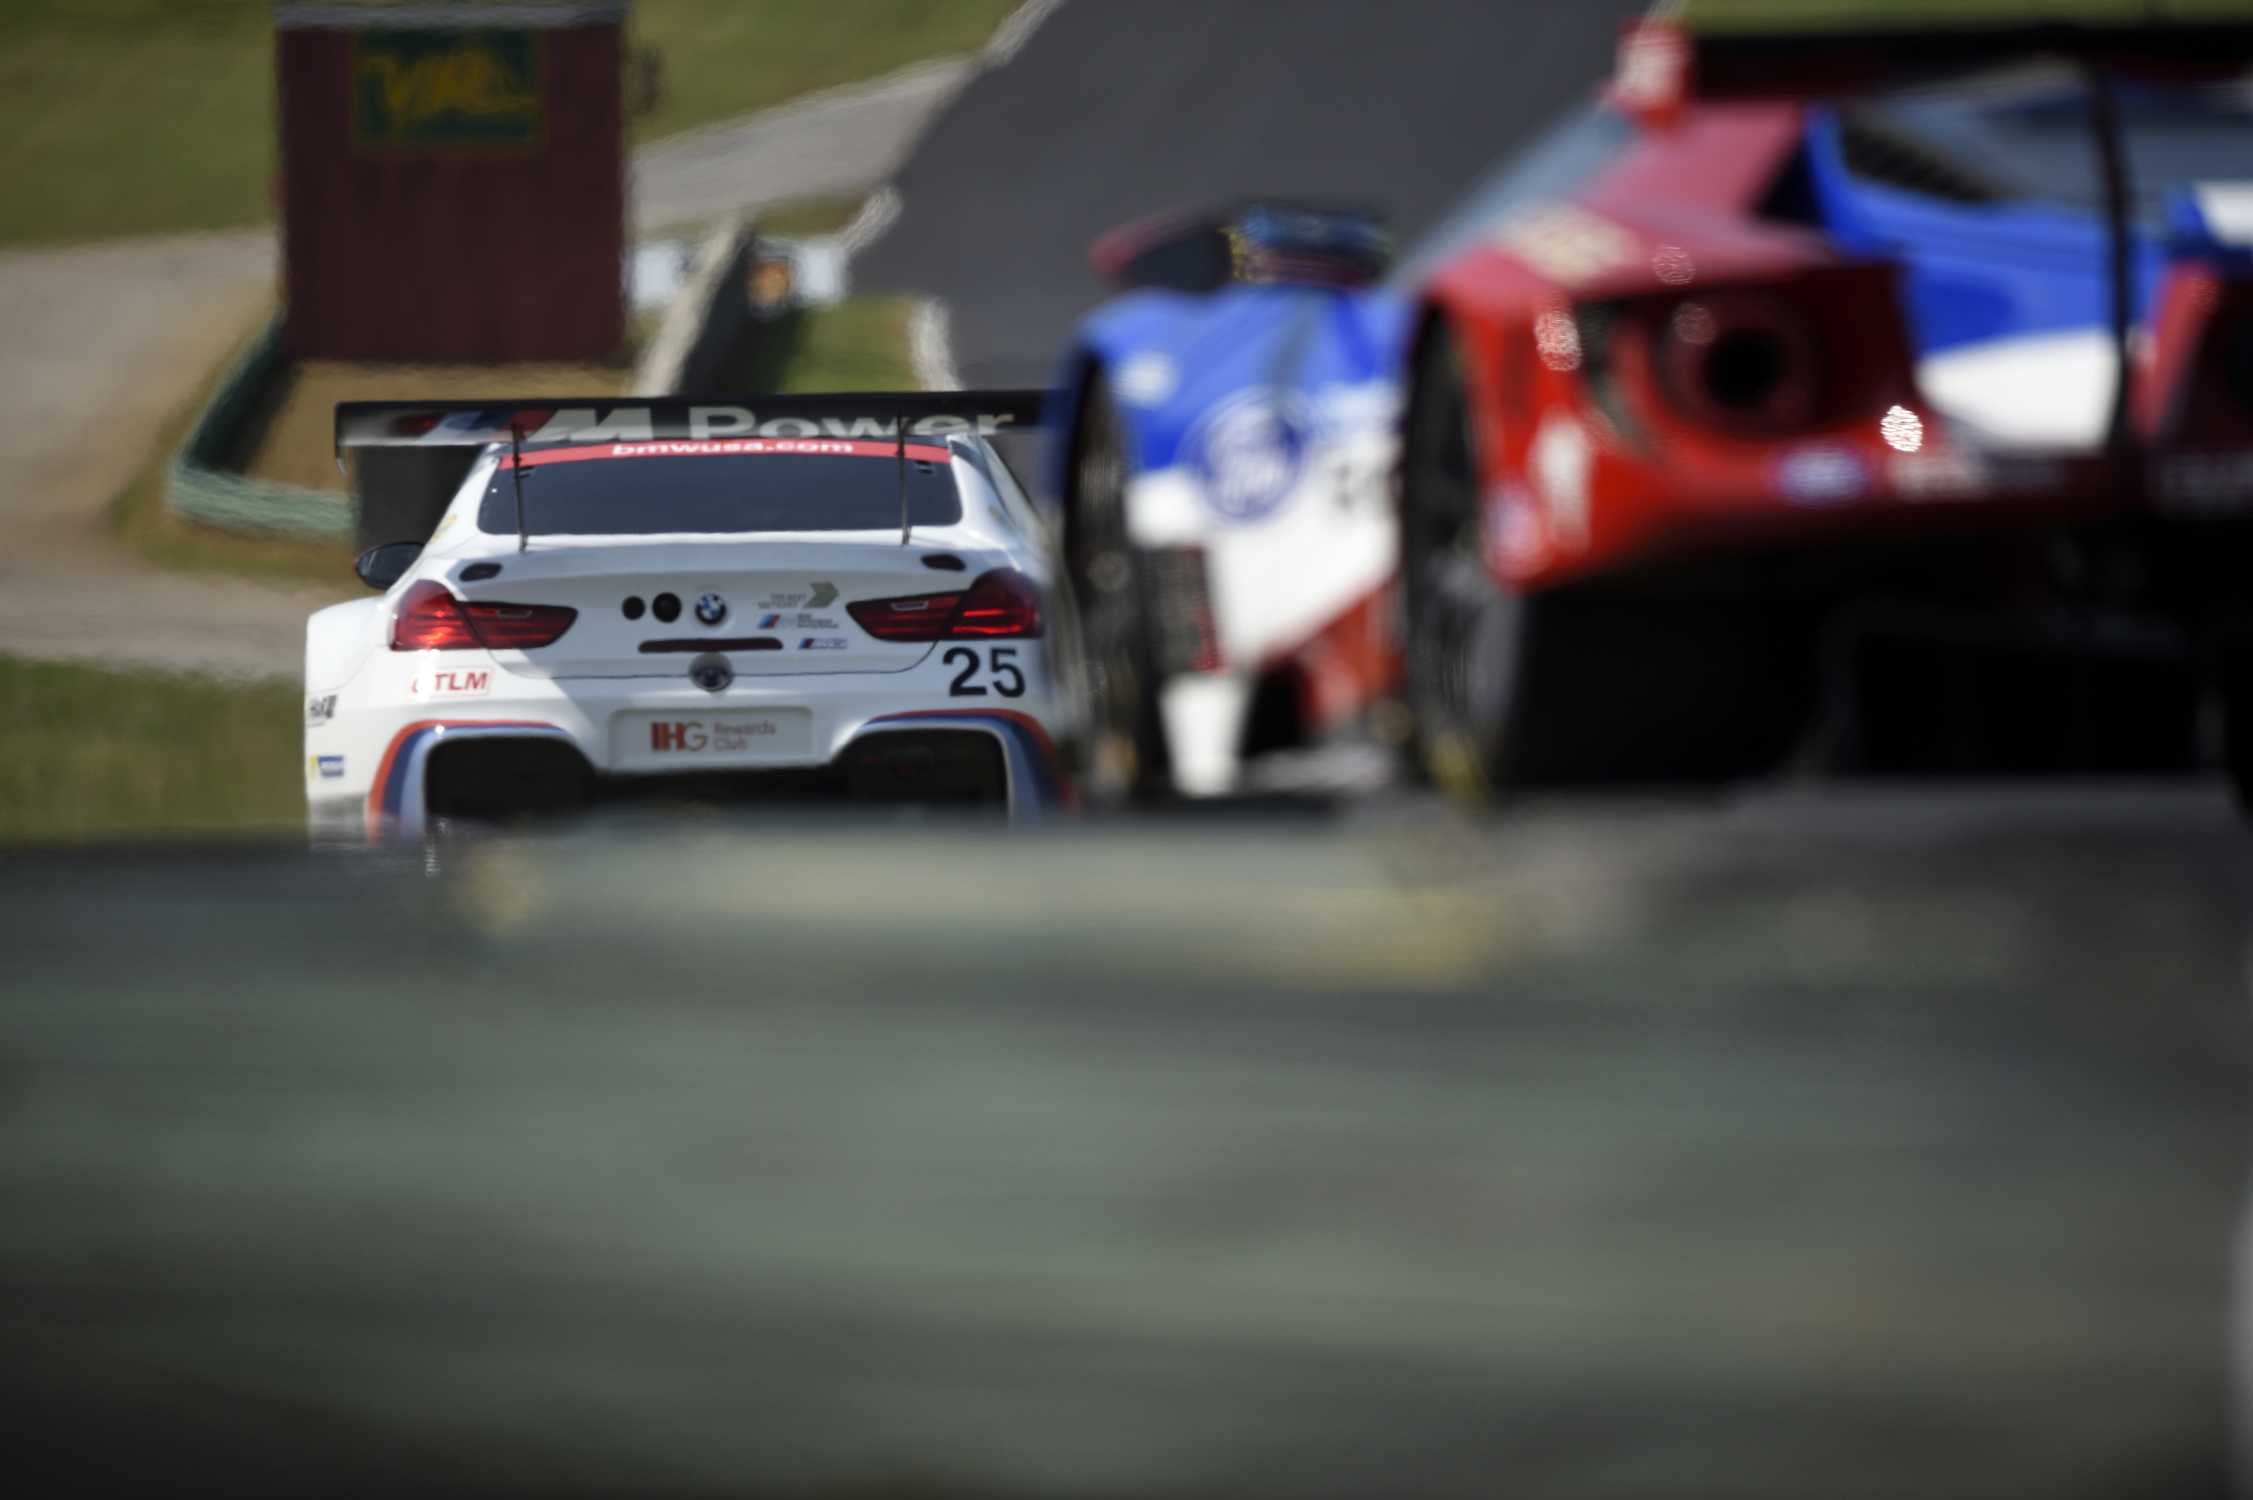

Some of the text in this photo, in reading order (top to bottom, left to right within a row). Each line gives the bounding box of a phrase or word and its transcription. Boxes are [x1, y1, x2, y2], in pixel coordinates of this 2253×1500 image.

[526, 406, 1014, 442] M Power
[611, 440, 854, 456] bmwusa.com
[943, 646, 1026, 698] 25
[651, 721, 709, 752] IHG
